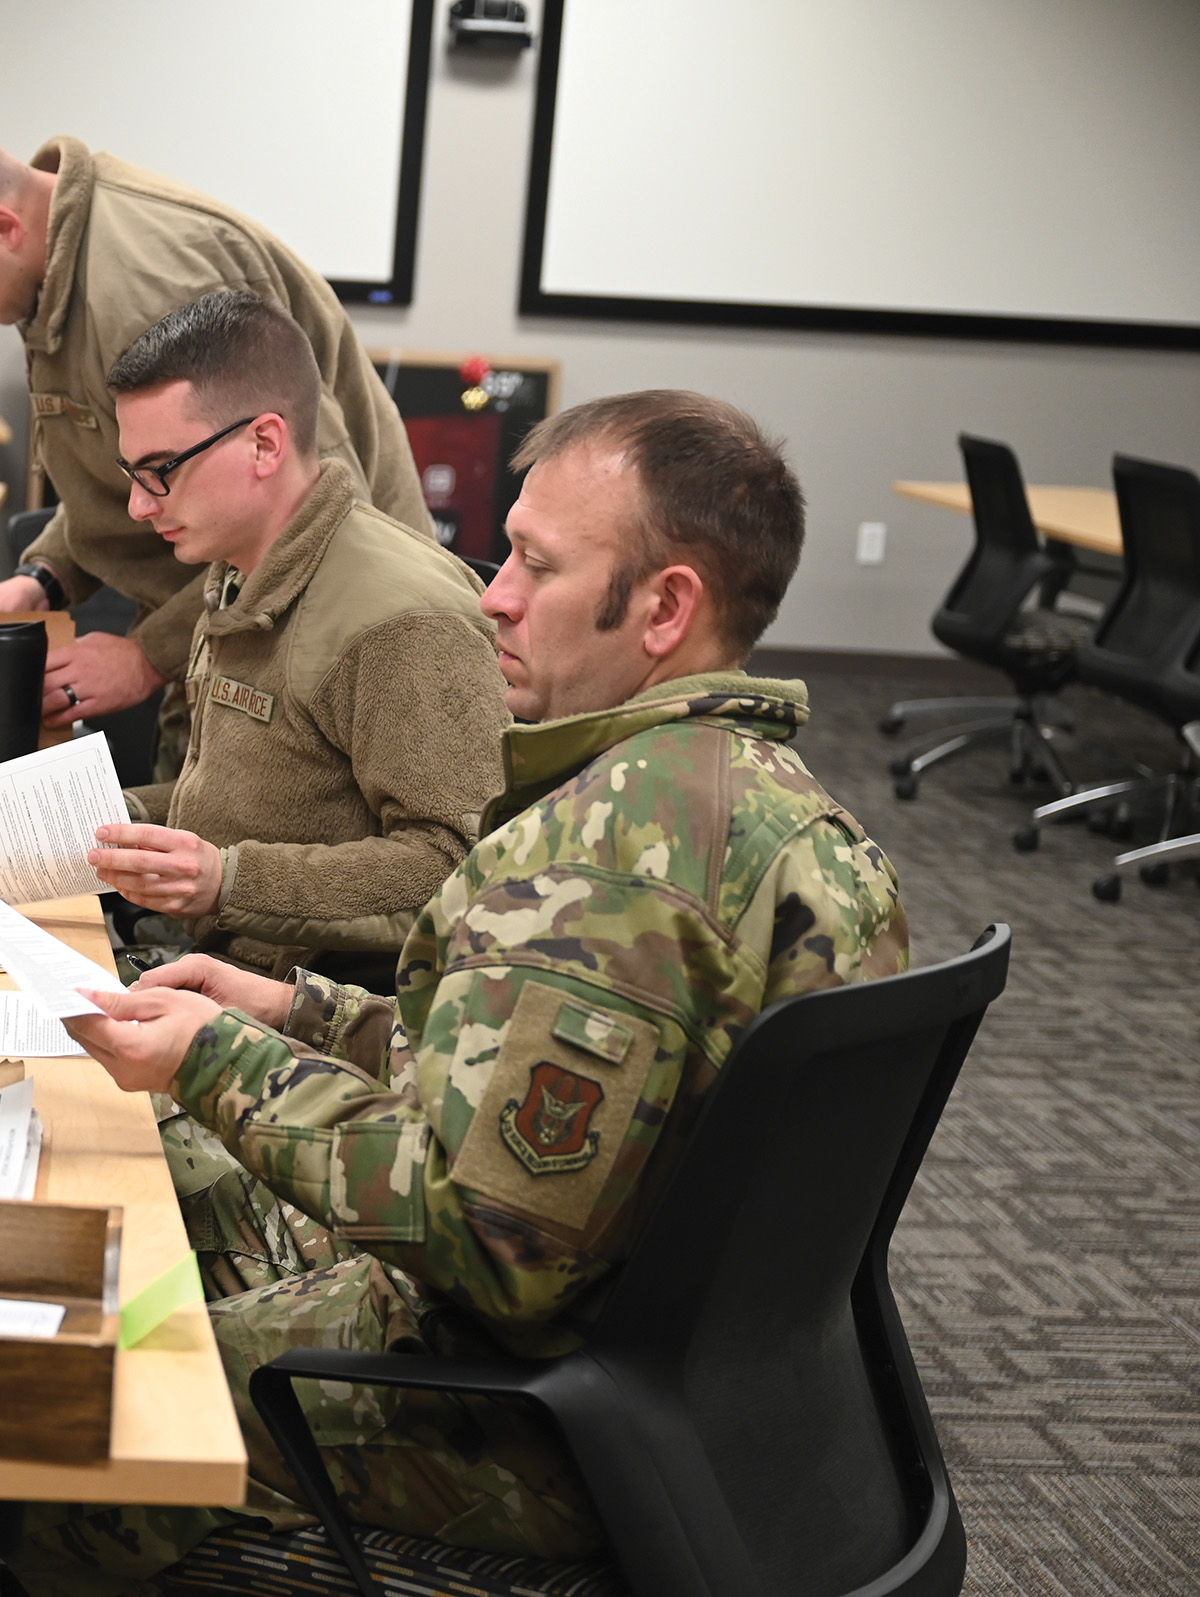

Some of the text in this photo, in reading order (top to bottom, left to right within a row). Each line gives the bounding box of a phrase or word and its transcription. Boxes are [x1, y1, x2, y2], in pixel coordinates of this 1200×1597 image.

[211, 679, 268, 718] U.S. AIR RCE
